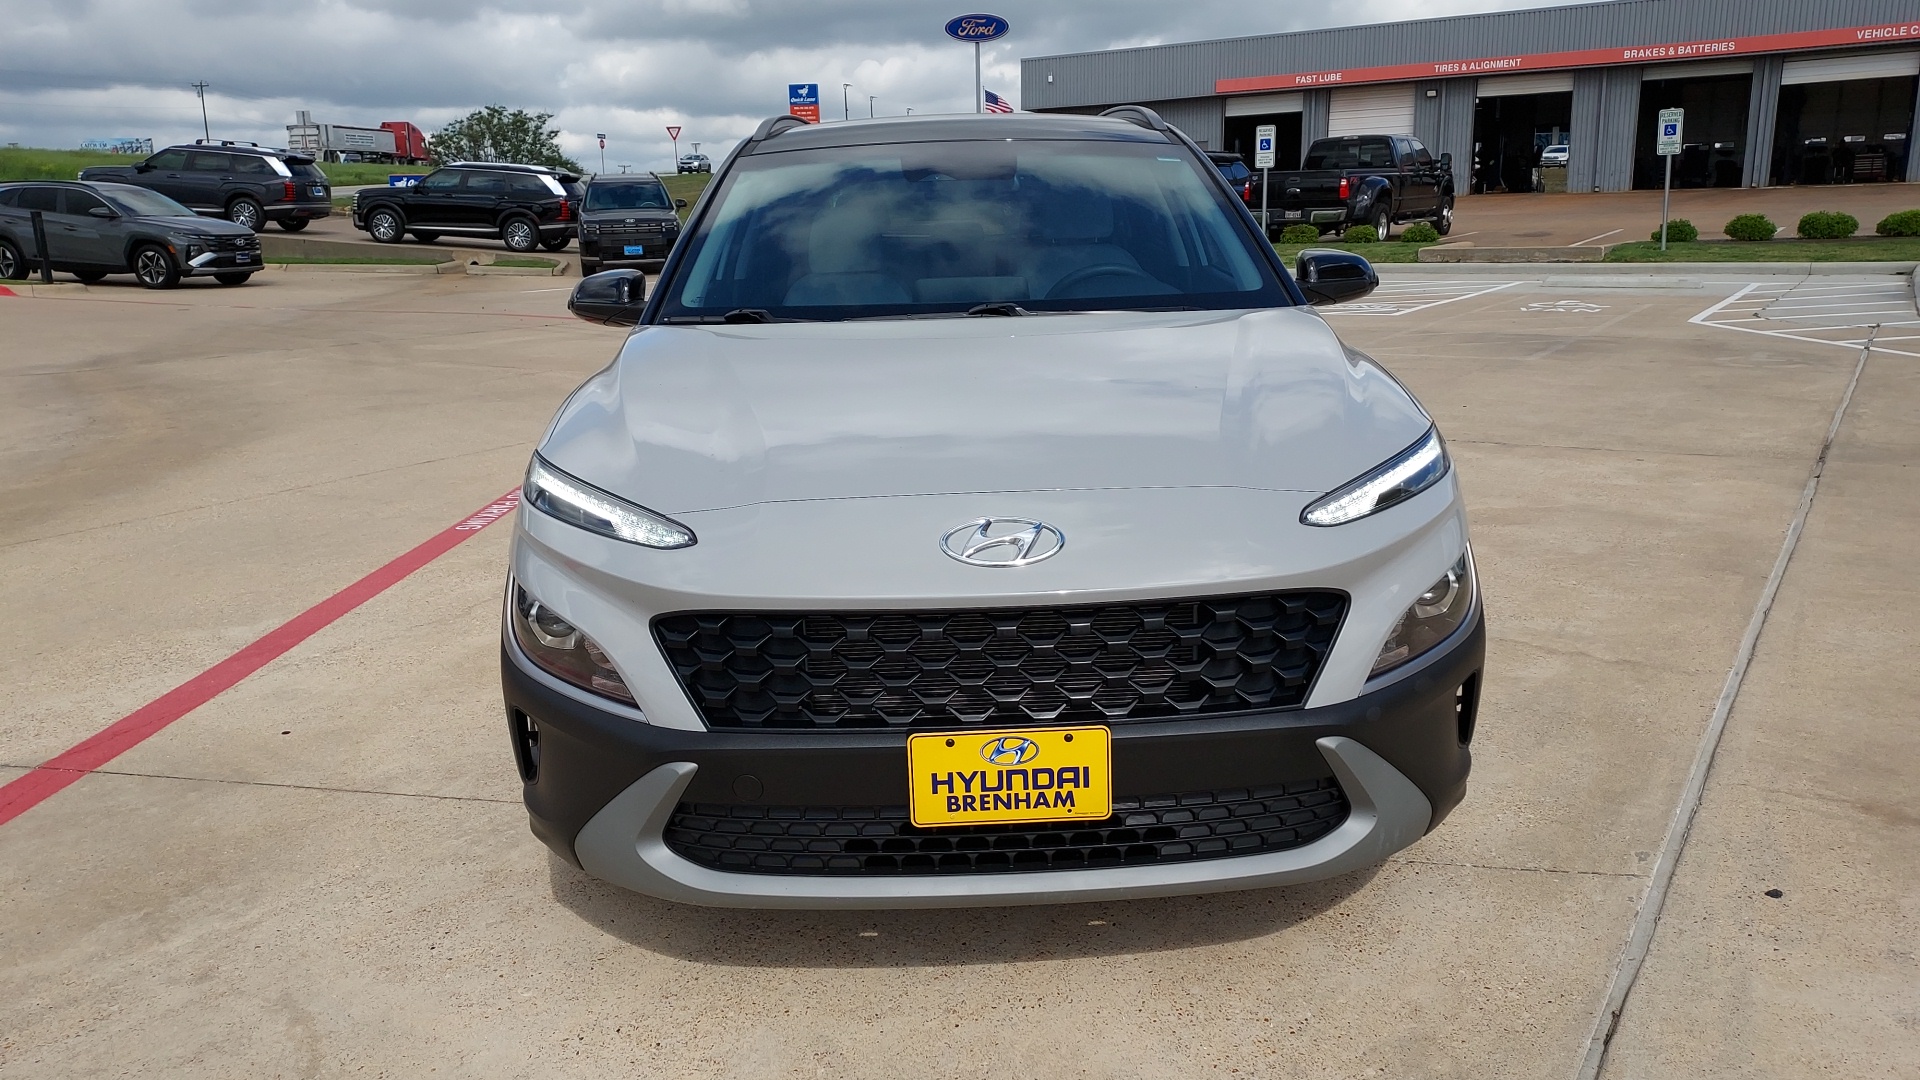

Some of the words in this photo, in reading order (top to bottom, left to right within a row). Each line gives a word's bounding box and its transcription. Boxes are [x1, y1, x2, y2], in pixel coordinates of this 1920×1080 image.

[958, 18, 996, 36] Ford
[1856, 26, 1908, 39] VEHICLE
[1911, 25, 1920, 35] C
[1624, 47, 1666, 59] BRAKES
[1668, 46, 1675, 55] &
[1678, 42, 1735, 54] BATTERIES
[1434, 63, 1460, 73] TIRES
[1461, 62, 1468, 71] &
[1469, 58, 1522, 70] ALIGNMENT
[1295, 74, 1318, 84] FAST
[1319, 72, 1343, 82] LUBE
[931, 766, 1090, 794] HYUNDAI
[947, 791, 1076, 812] BRENHAM
